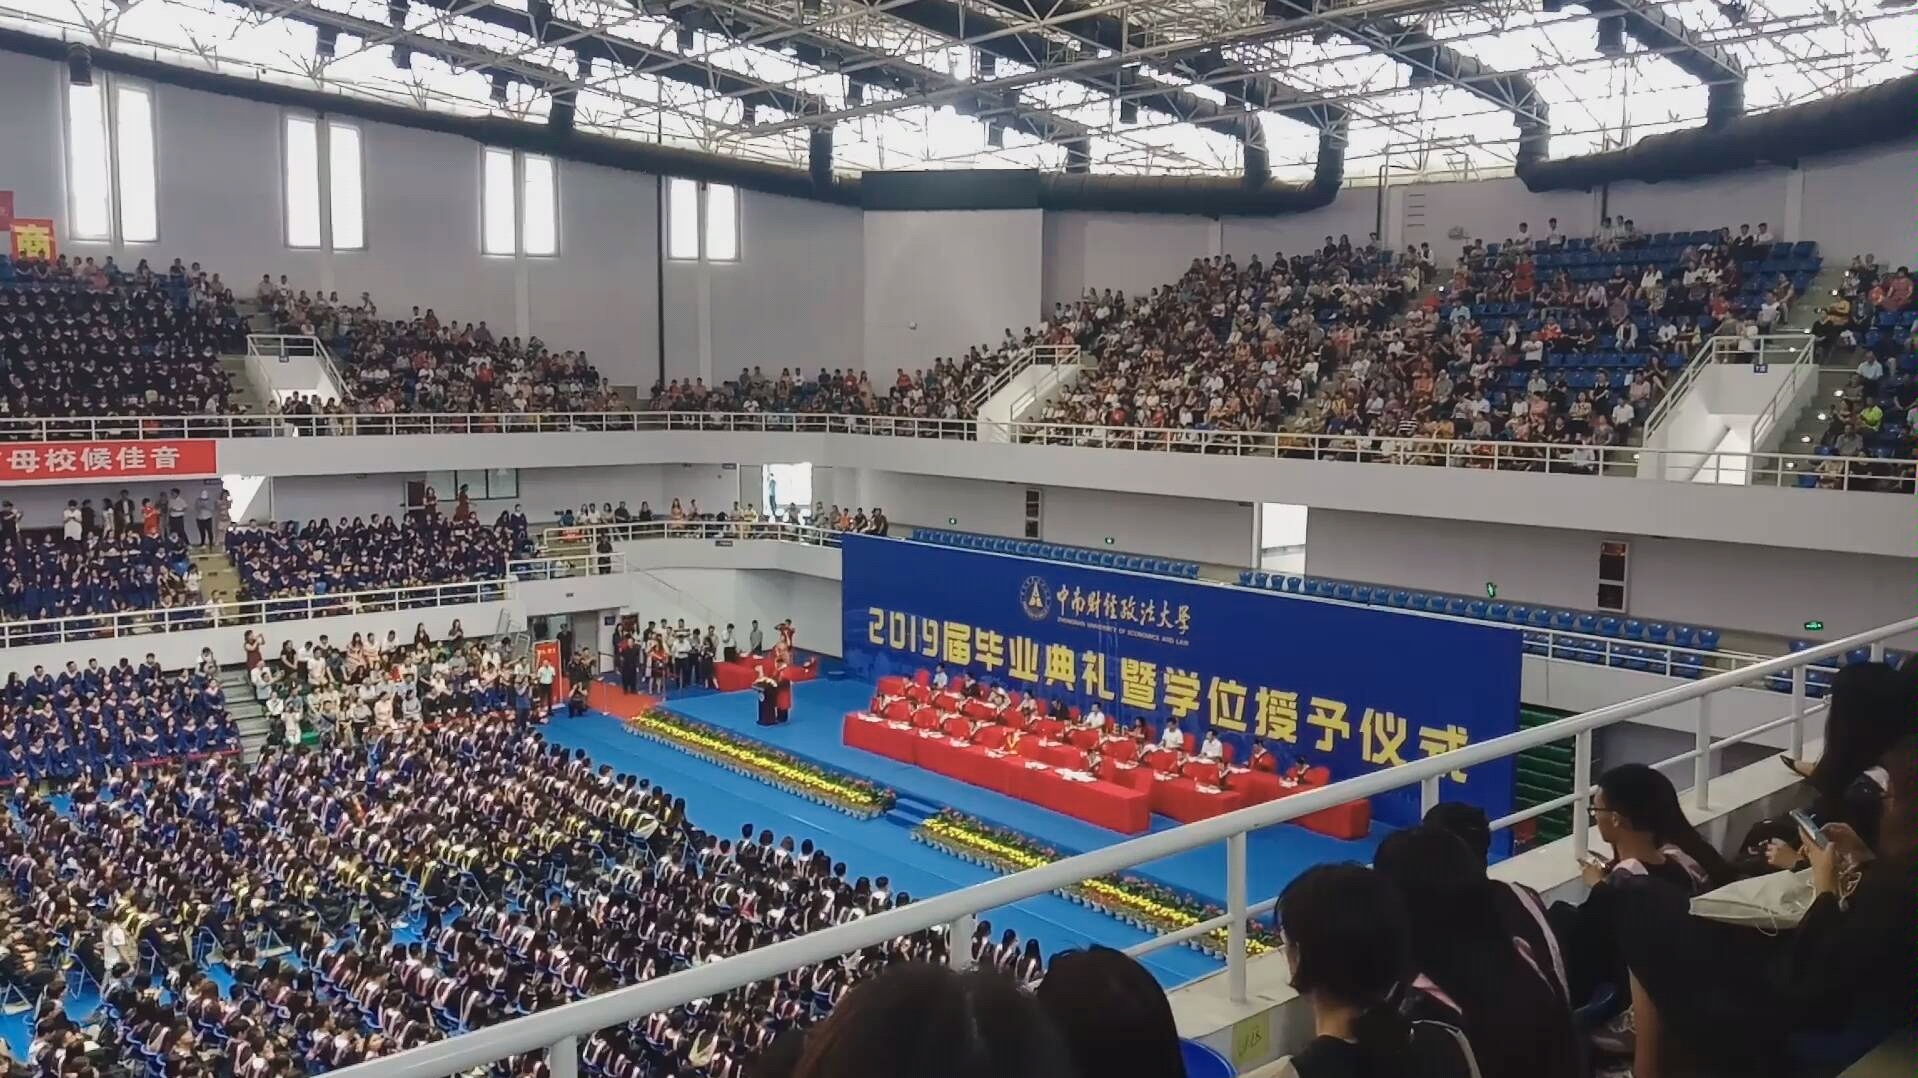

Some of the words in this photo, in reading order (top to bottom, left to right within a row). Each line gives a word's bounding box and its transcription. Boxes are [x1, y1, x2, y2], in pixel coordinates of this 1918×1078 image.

[6, 446, 180, 473] 母校候佳音
